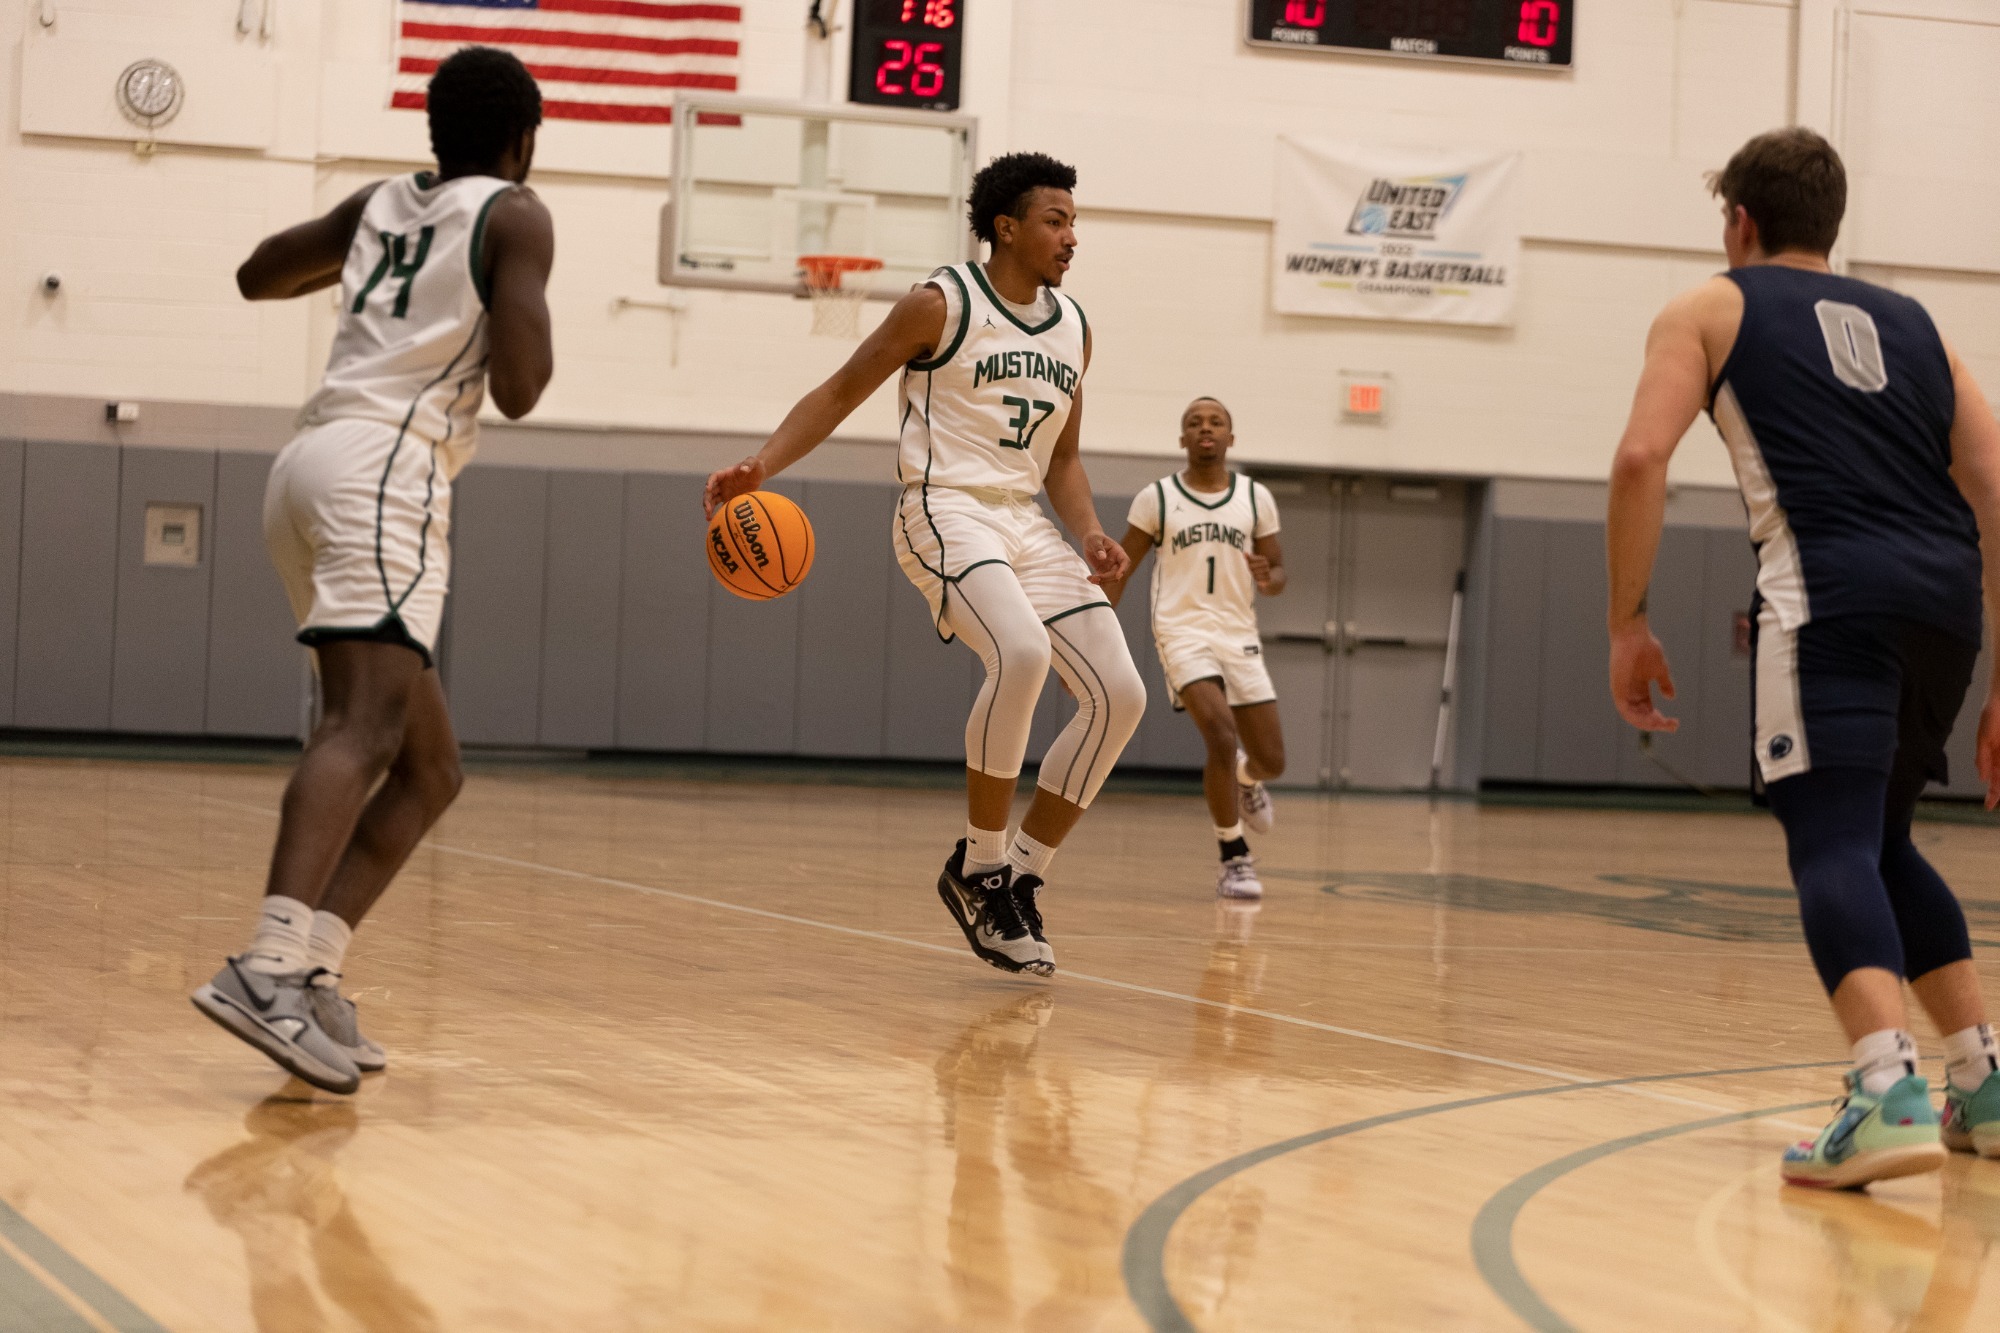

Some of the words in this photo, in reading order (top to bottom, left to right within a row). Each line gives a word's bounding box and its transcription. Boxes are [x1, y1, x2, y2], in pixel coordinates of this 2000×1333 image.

[1271, 27, 1319, 44] POINTS
[1518, 1, 1559, 47] 10
[1390, 36, 1438, 54] MATCH
[1504, 46, 1550, 63] POINTS
[876, 40, 944, 96] 26
[1365, 178, 1448, 208] UNITED
[1388, 209, 1439, 231] EAST
[1285, 254, 1381, 277] WOMEN'S
[1384, 259, 1506, 287] BASKETBALL
[1814, 299, 1888, 393] 0
[999, 395, 1055, 450] 37
[711, 526, 739, 575] NCAA
[733, 500, 769, 570] Wilson
[1206, 556, 1215, 594] 1
